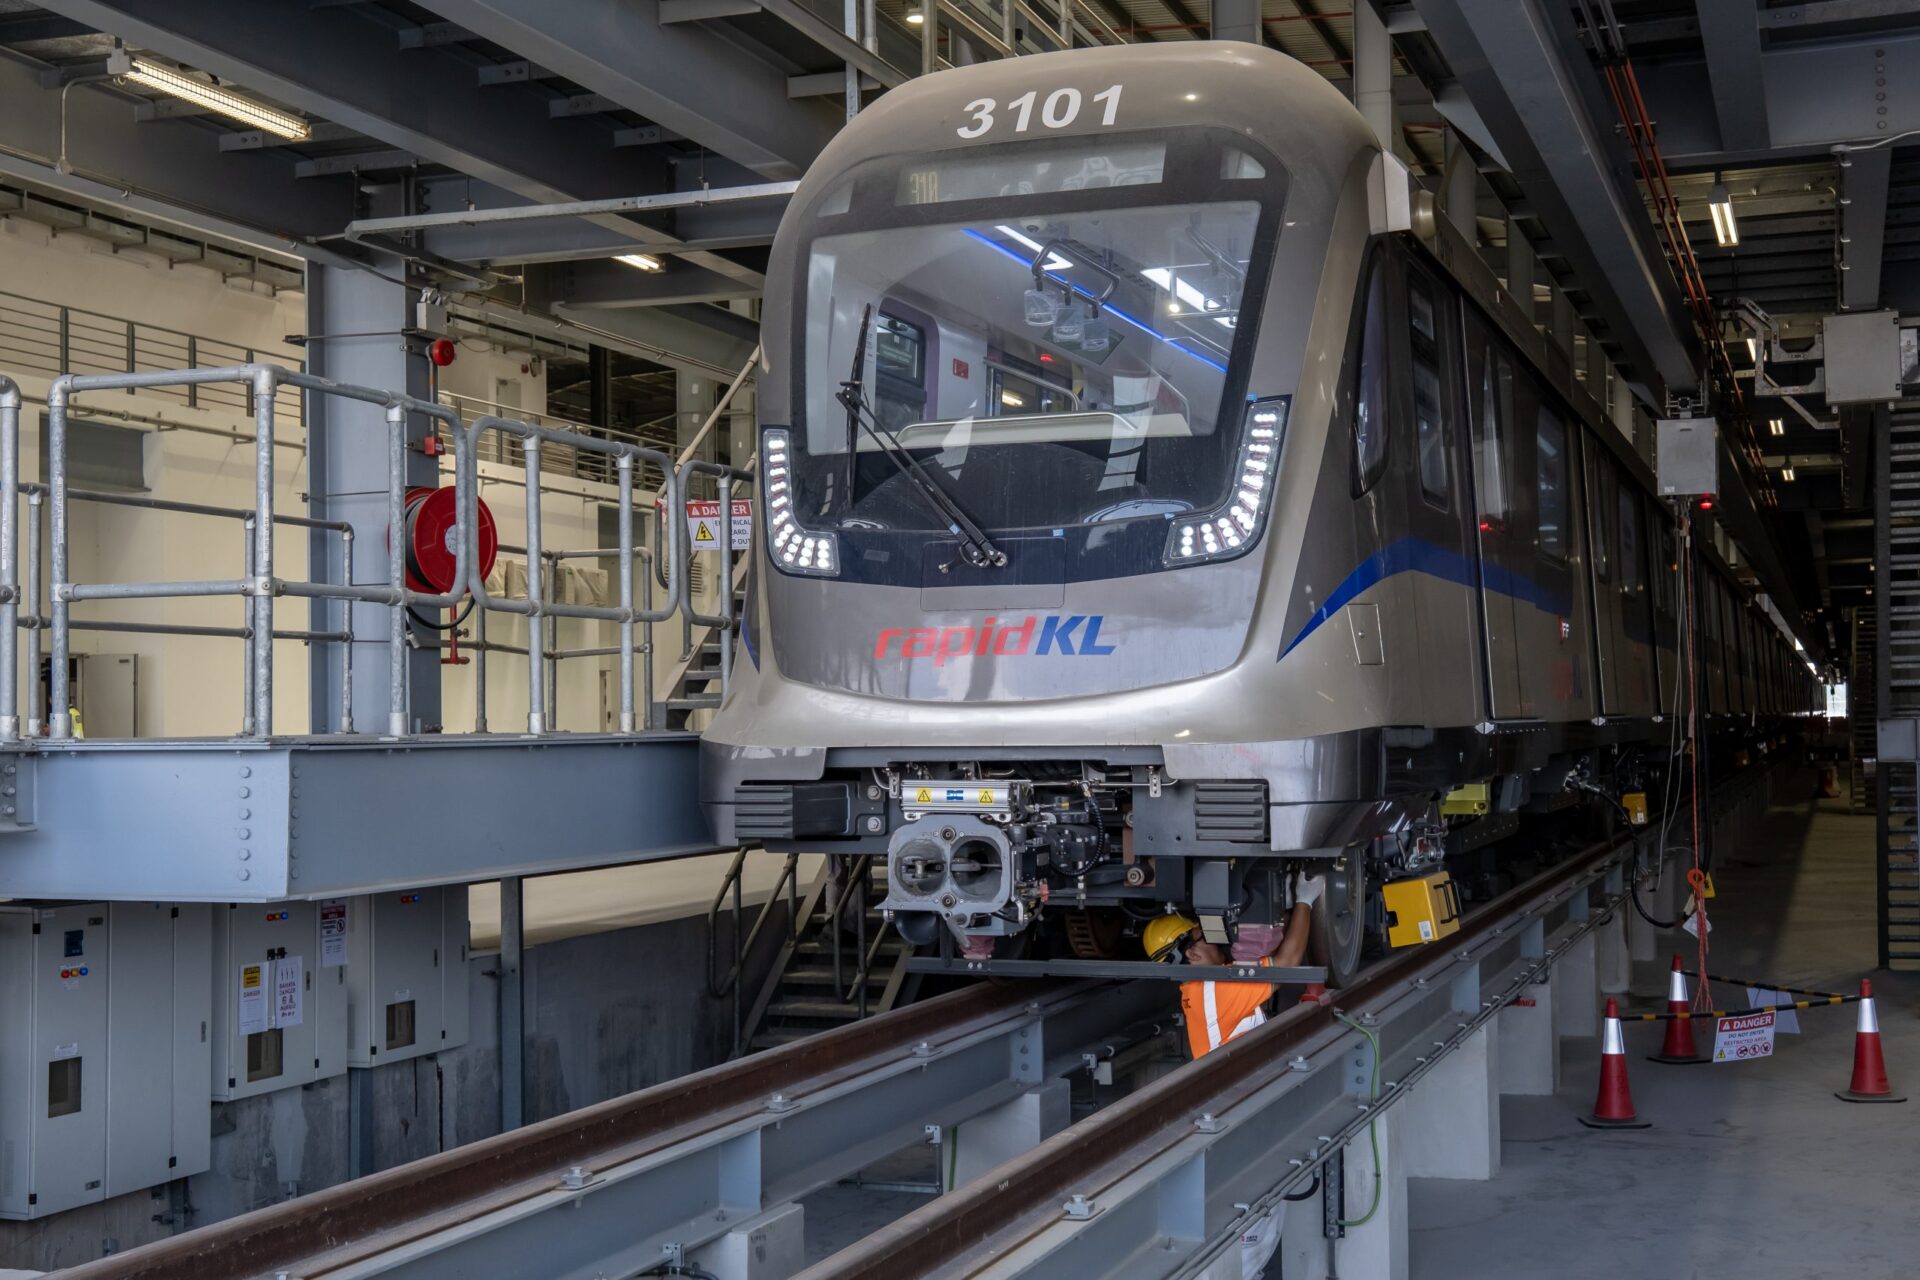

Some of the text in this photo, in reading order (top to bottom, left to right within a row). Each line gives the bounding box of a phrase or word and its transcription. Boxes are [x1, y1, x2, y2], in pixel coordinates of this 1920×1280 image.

[956, 84, 1123, 139] 3101
[702, 505, 747, 516] DAER
[874, 615, 1117, 667] rapidKL
[1733, 1015, 1772, 1029] DANGER
